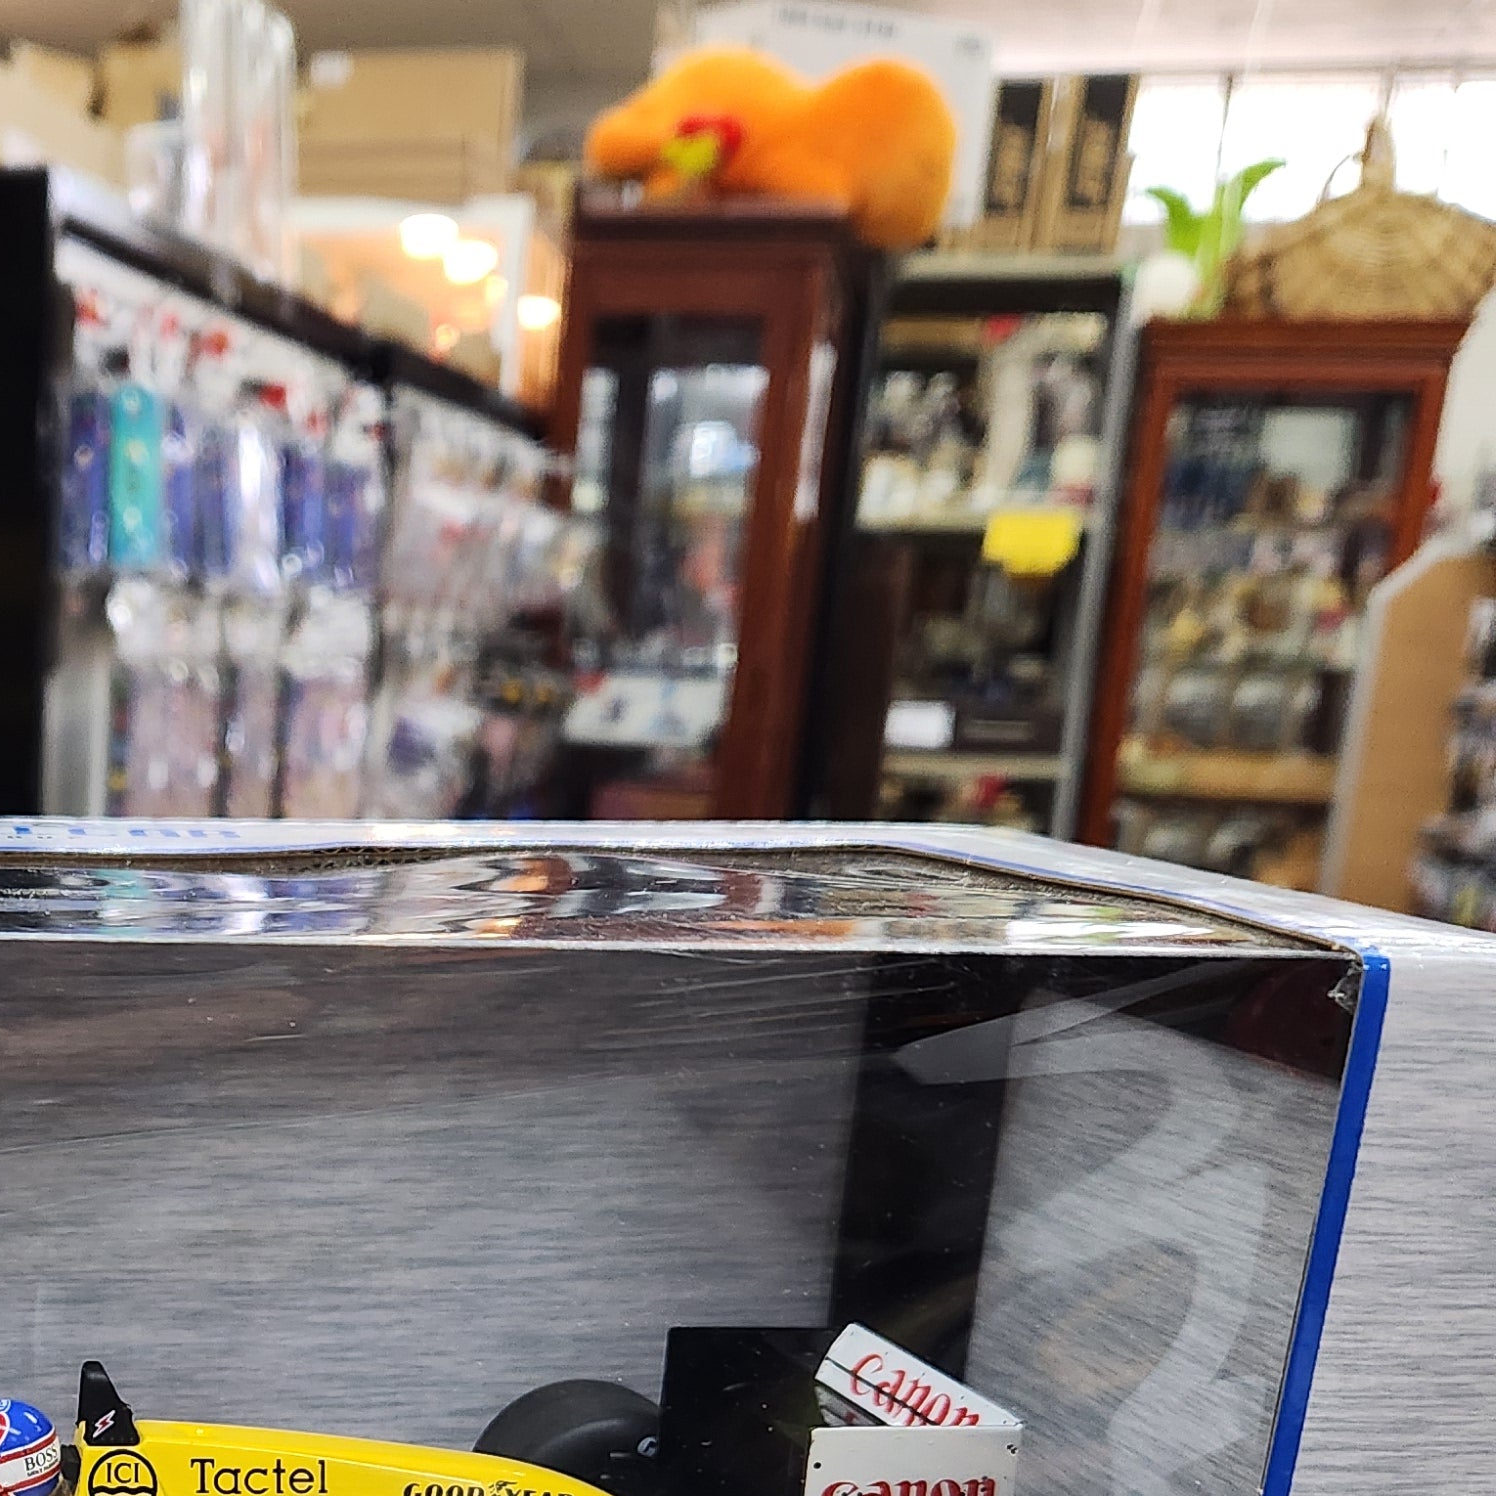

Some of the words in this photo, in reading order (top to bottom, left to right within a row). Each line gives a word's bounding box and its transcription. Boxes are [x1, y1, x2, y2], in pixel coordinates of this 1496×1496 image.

[25, 1444, 58, 1472] BOSS
[107, 1462, 140, 1483] ICI
[190, 1458, 328, 1495] Tactel
